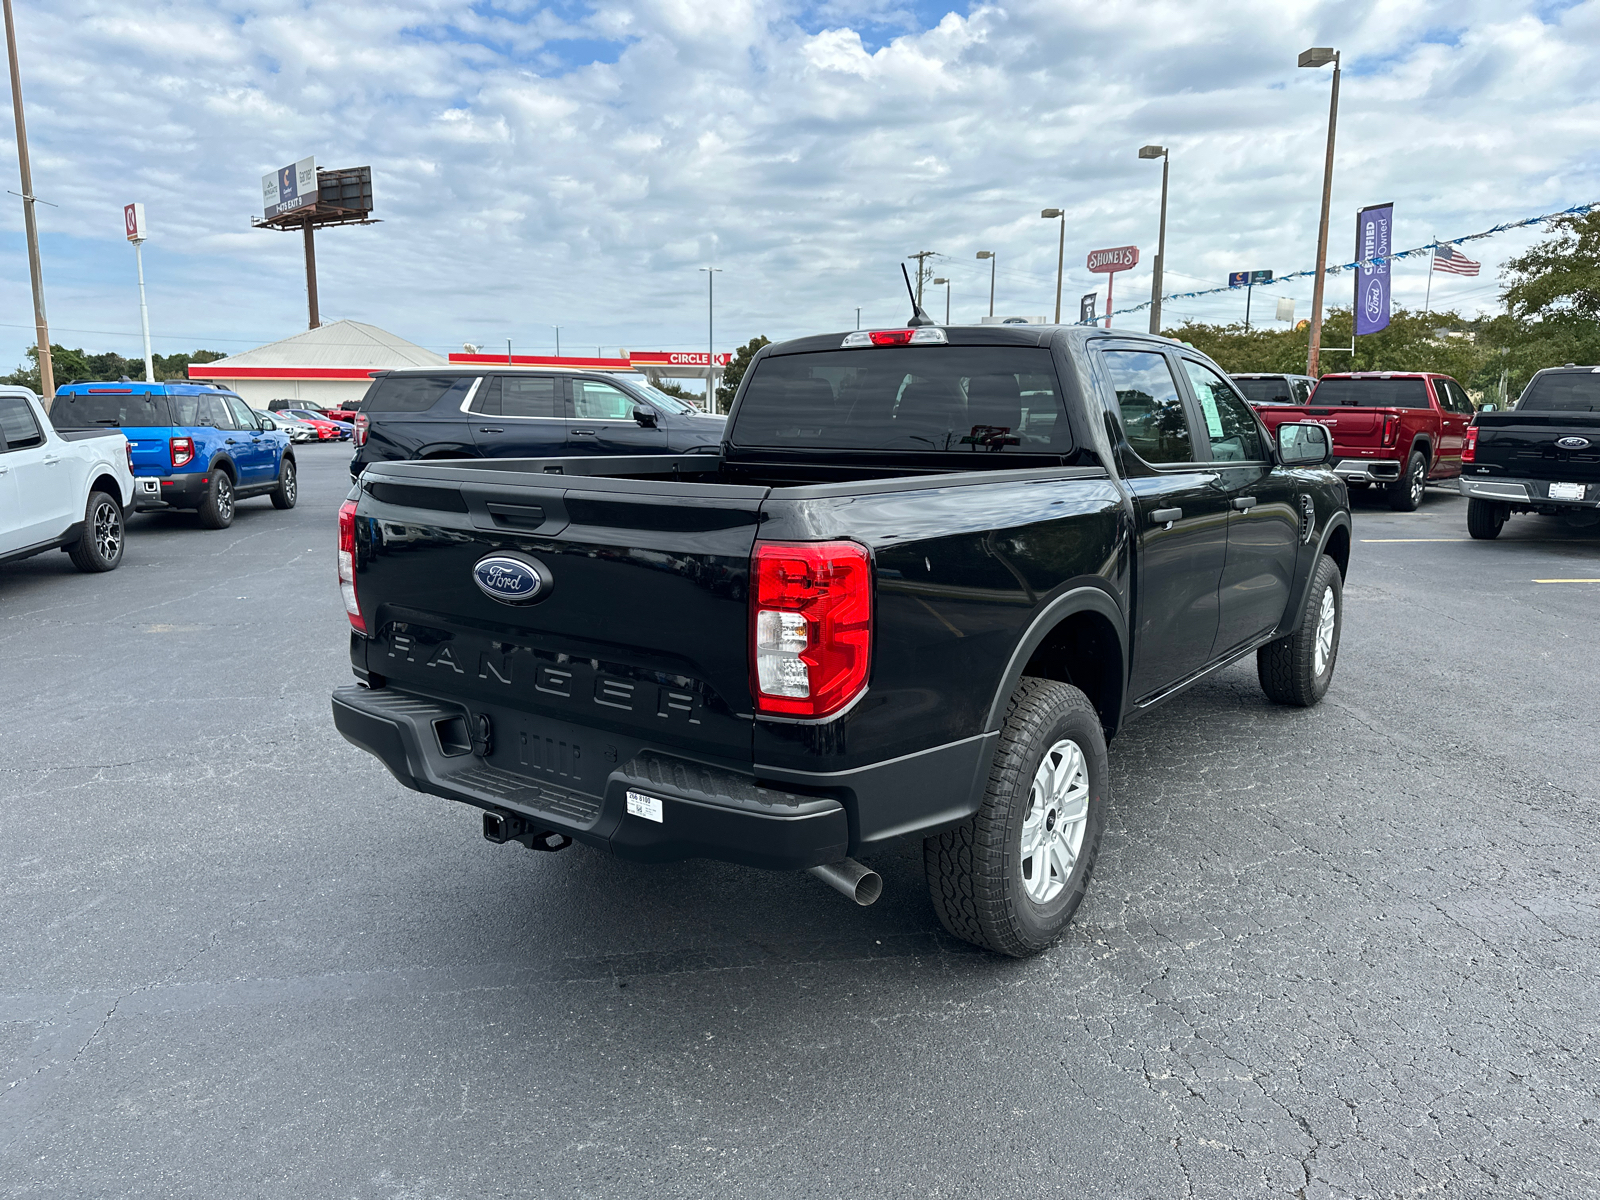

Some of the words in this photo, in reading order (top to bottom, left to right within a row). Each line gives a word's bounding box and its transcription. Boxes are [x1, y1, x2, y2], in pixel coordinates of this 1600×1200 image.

[287, 198, 299, 210] EXIT
[1377, 218, 1388, 274] Pr-Owned
[1089, 249, 1133, 269] SHONEY'S
[1367, 287, 1380, 314] Ford
[670, 353, 708, 364] CIRCLE
[713, 354, 723, 365] K
[486, 565, 522, 590] Ford
[387, 630, 704, 725] RANGER
